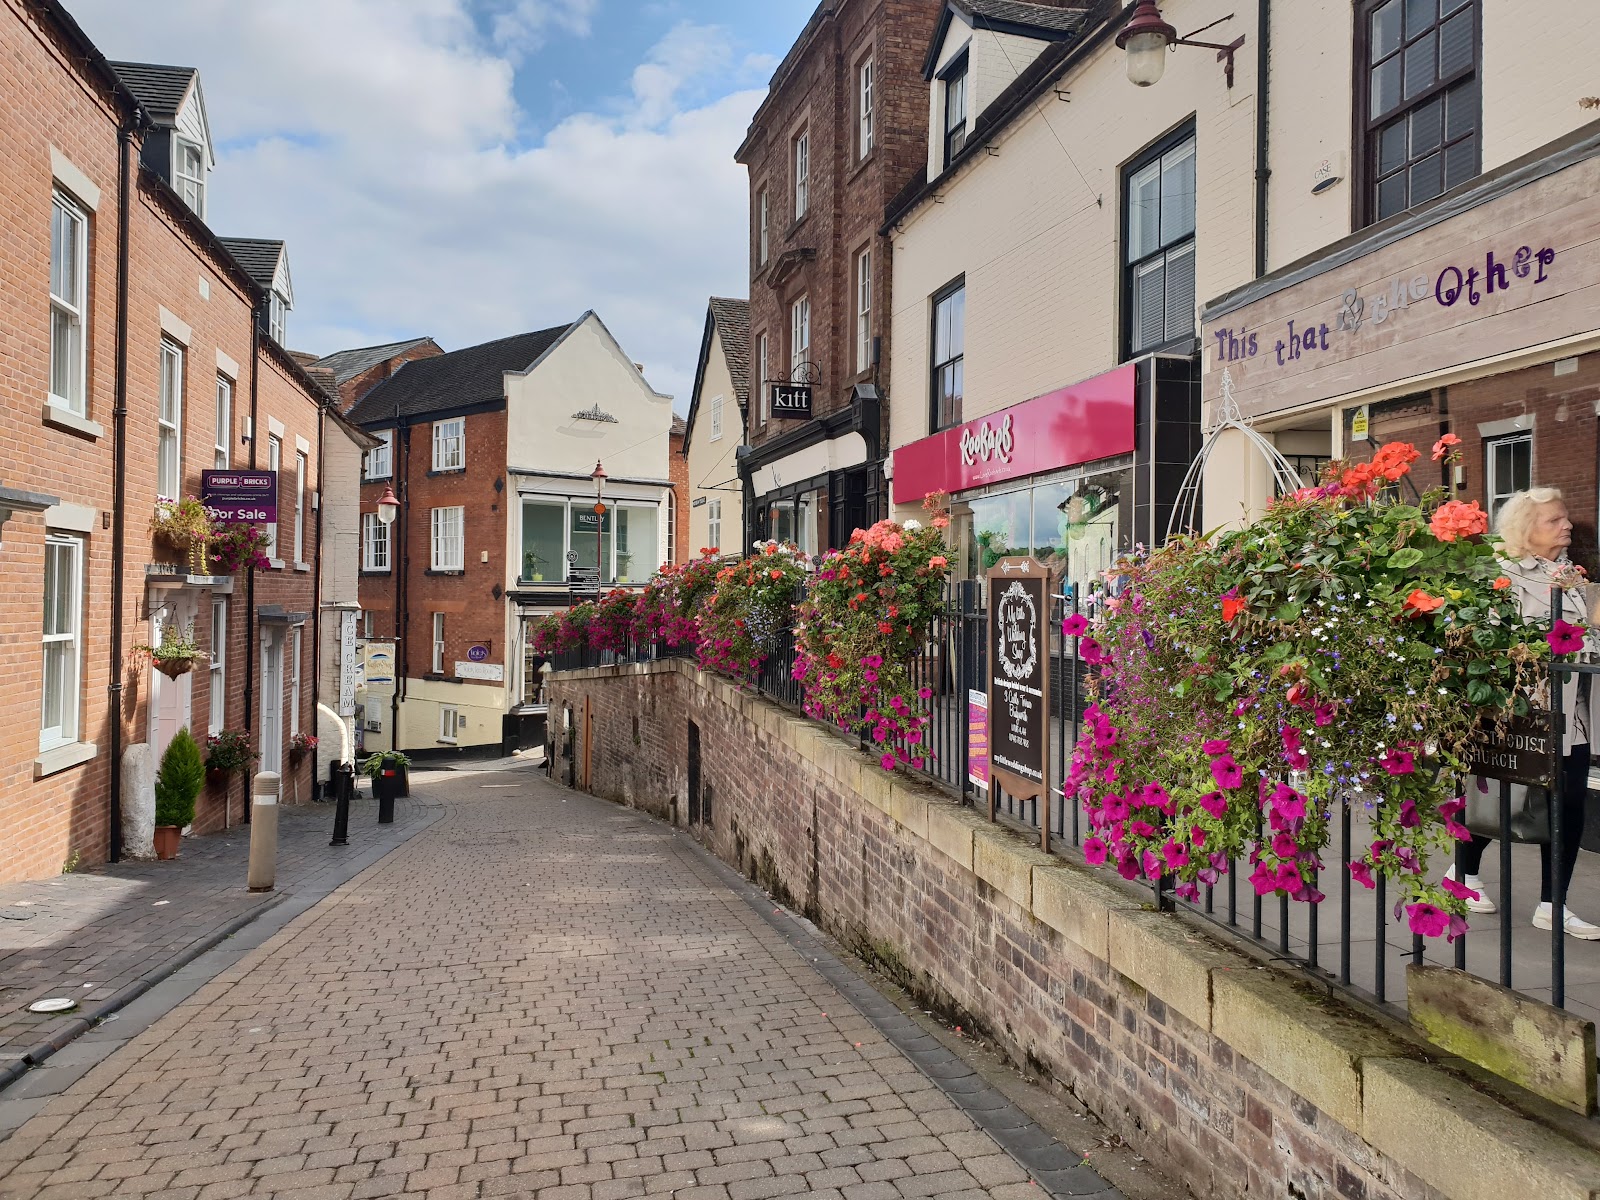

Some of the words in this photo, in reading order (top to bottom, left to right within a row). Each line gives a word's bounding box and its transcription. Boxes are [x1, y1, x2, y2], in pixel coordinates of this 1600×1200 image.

[1214, 326, 1258, 362] This
[1275, 319, 1330, 366] that
[1370, 273, 1429, 325] the
[1435, 245, 1555, 307] Other
[774, 387, 808, 408] kitt
[211, 477, 238, 485] PURPLE
[243, 478, 268, 486] BRICKS
[237, 508, 267, 520] Sale
[579, 514, 605, 523] BENTLY
[345, 613, 354, 647] ICE
[342, 653, 354, 708] CREAM
[1466, 750, 1518, 770] HURCH
